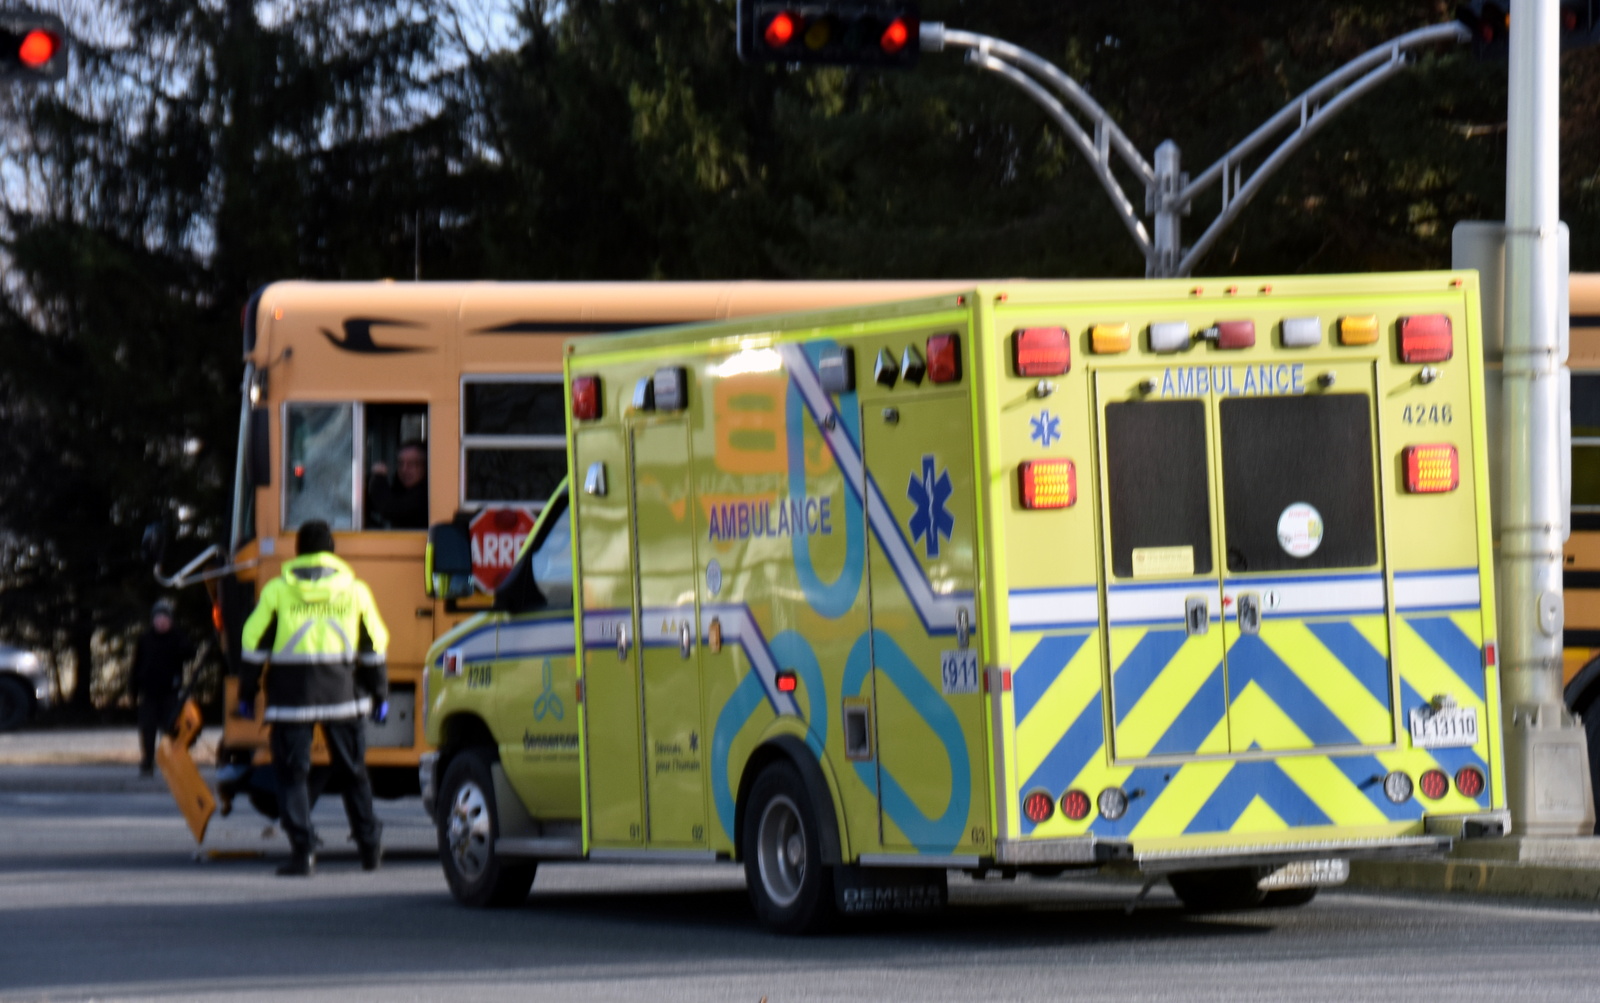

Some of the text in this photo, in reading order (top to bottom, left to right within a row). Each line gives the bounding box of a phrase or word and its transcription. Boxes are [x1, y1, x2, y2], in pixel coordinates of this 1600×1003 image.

[1161, 363, 1305, 399] AMBULANCE
[1402, 403, 1452, 426] 4246
[709, 496, 832, 542] AMBULANCE
